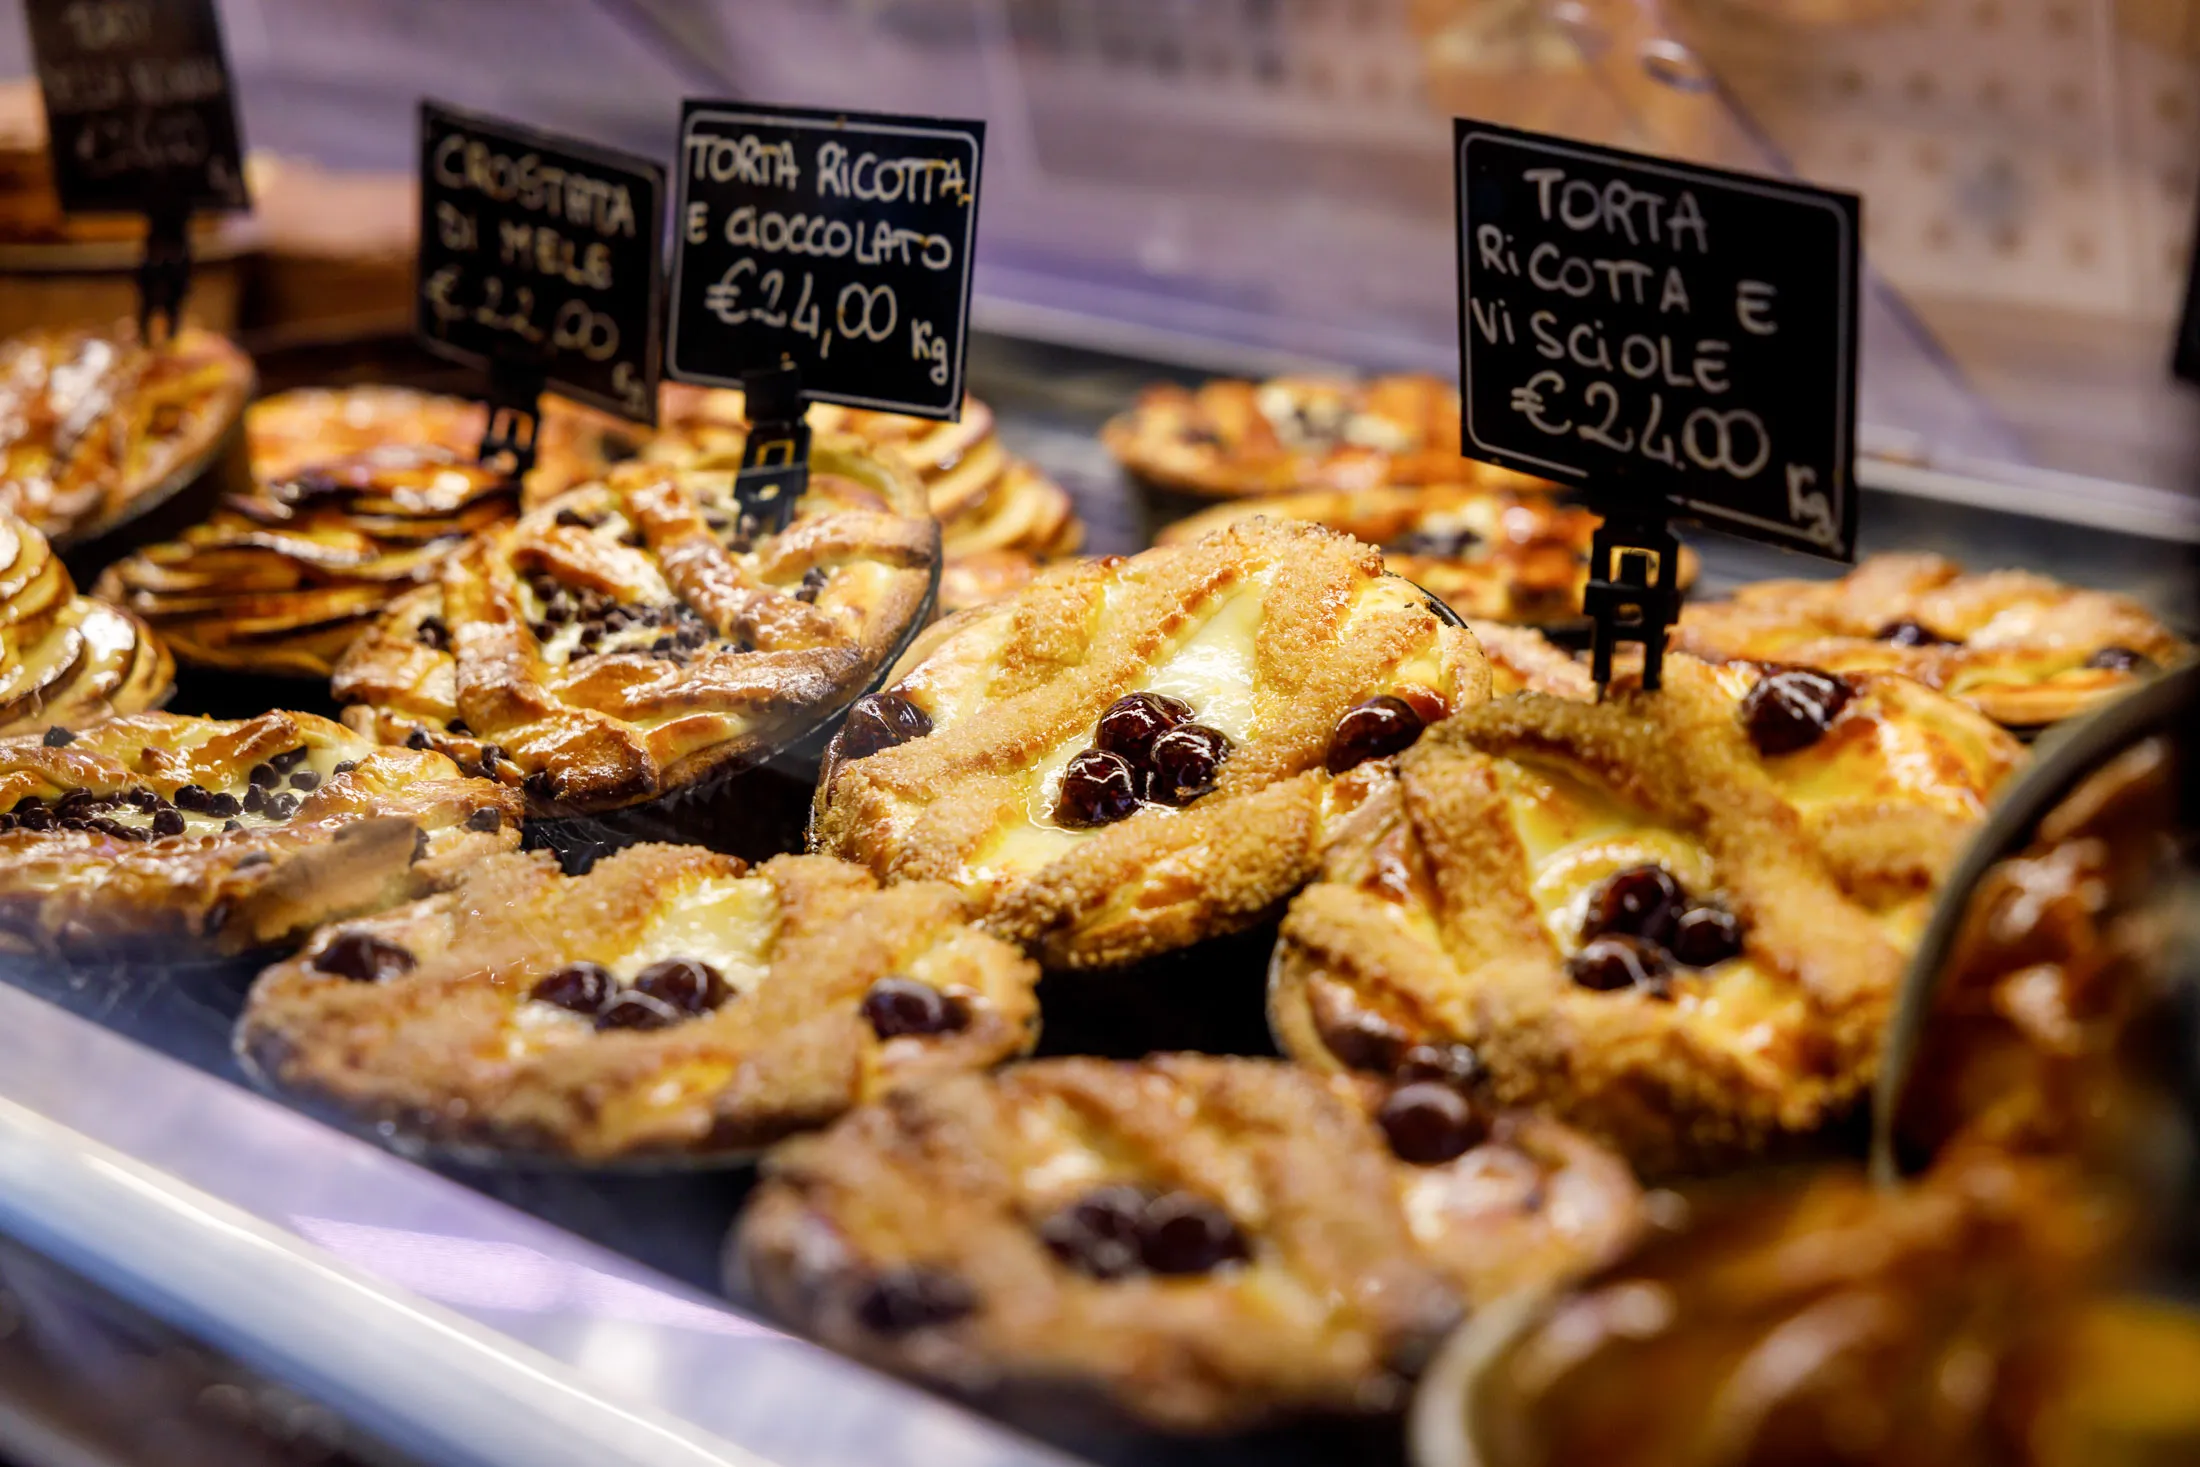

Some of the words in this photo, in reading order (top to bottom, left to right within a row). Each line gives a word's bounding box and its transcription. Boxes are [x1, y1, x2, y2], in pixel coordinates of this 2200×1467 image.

[434, 134, 636, 239] CROSTATA
[684, 134, 799, 191] TORTA
[686, 202, 709, 244] E
[1523, 168, 1708, 254] TORTA
[498, 220, 613, 290] MELE
[704, 258, 898, 359] €24,00
[911, 318, 948, 386] Kg
[1736, 280, 1778, 335] E
